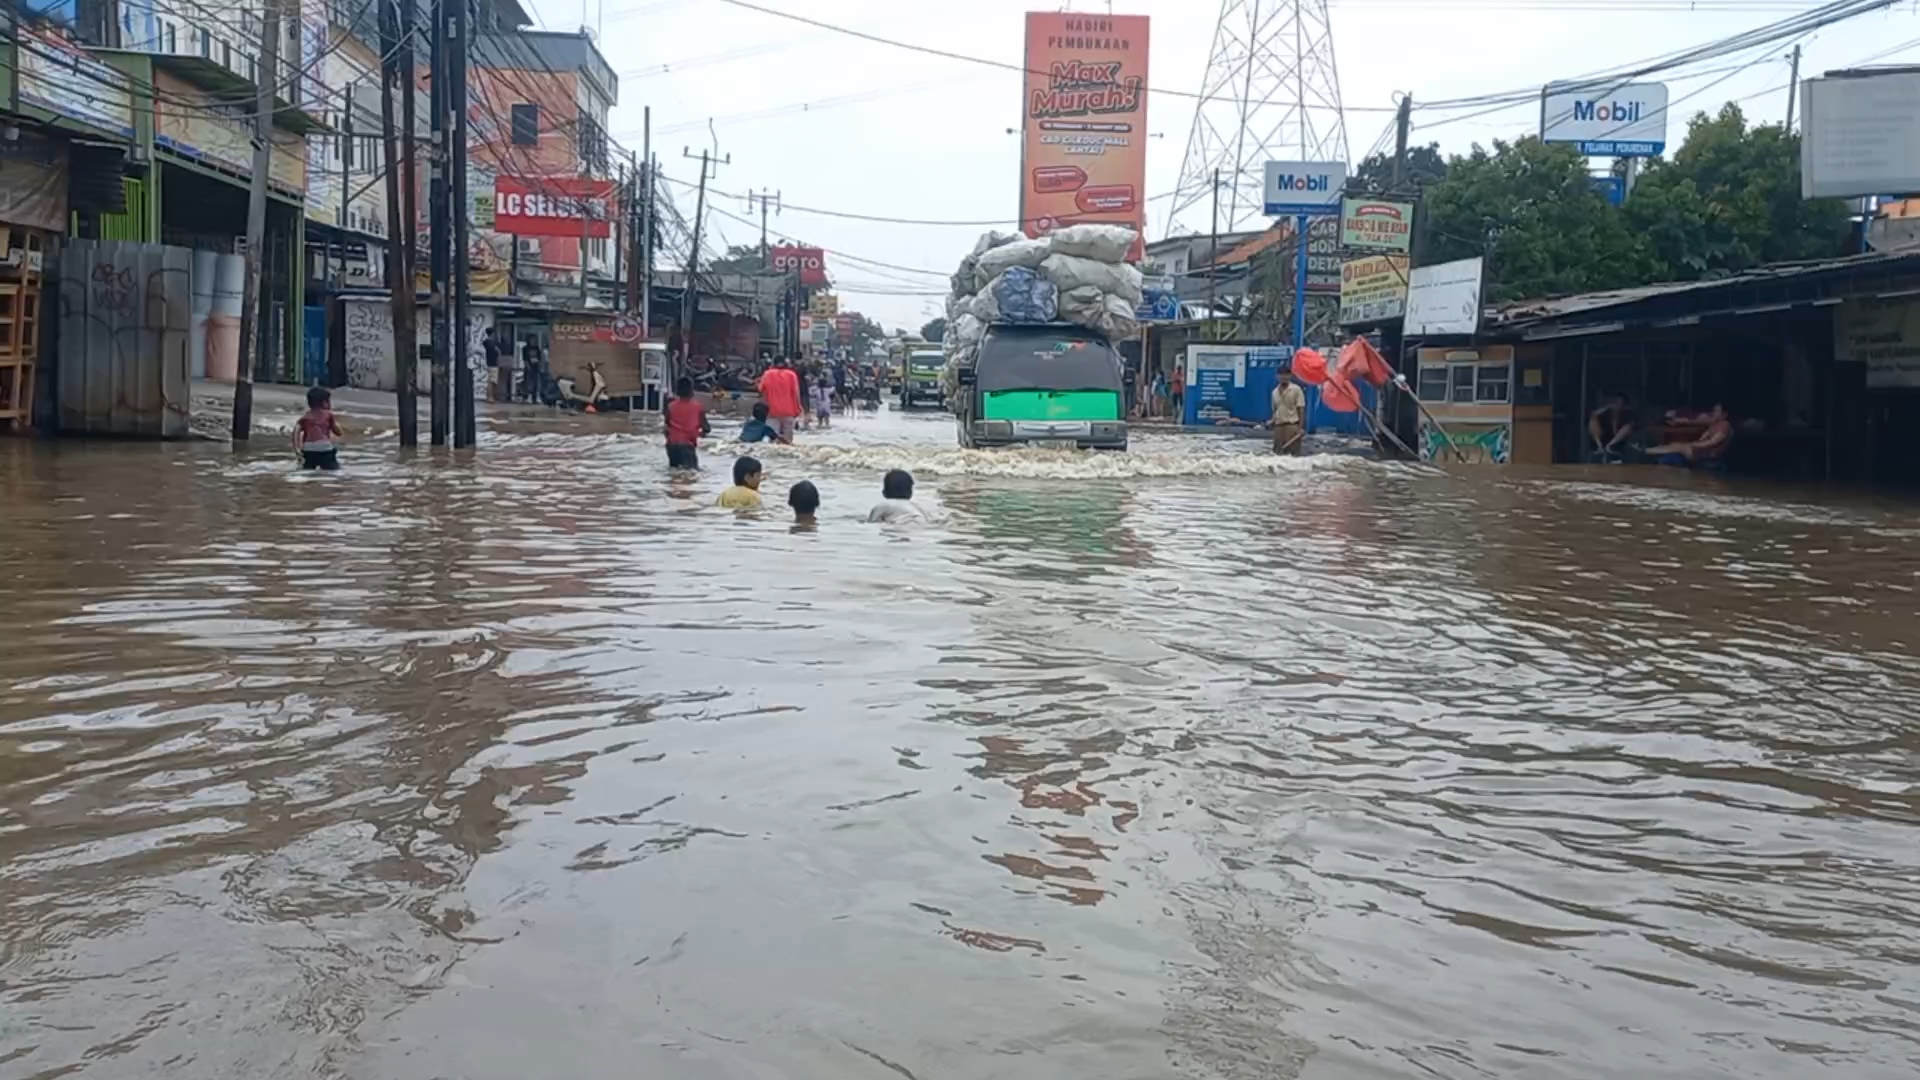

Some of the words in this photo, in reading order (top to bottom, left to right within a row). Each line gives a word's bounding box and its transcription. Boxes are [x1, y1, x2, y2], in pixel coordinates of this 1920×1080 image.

[1065, 19, 1113, 32] HADIRI
[1048, 36, 1130, 50] PEMBUKAAN
[1050, 60, 1121, 88] Max
[1031, 76, 1142, 118] Murah!
[1573, 100, 1640, 122] Mobil
[1278, 174, 1328, 191] Mobil
[497, 191, 521, 216] LC
[775, 256, 820, 272] goro
